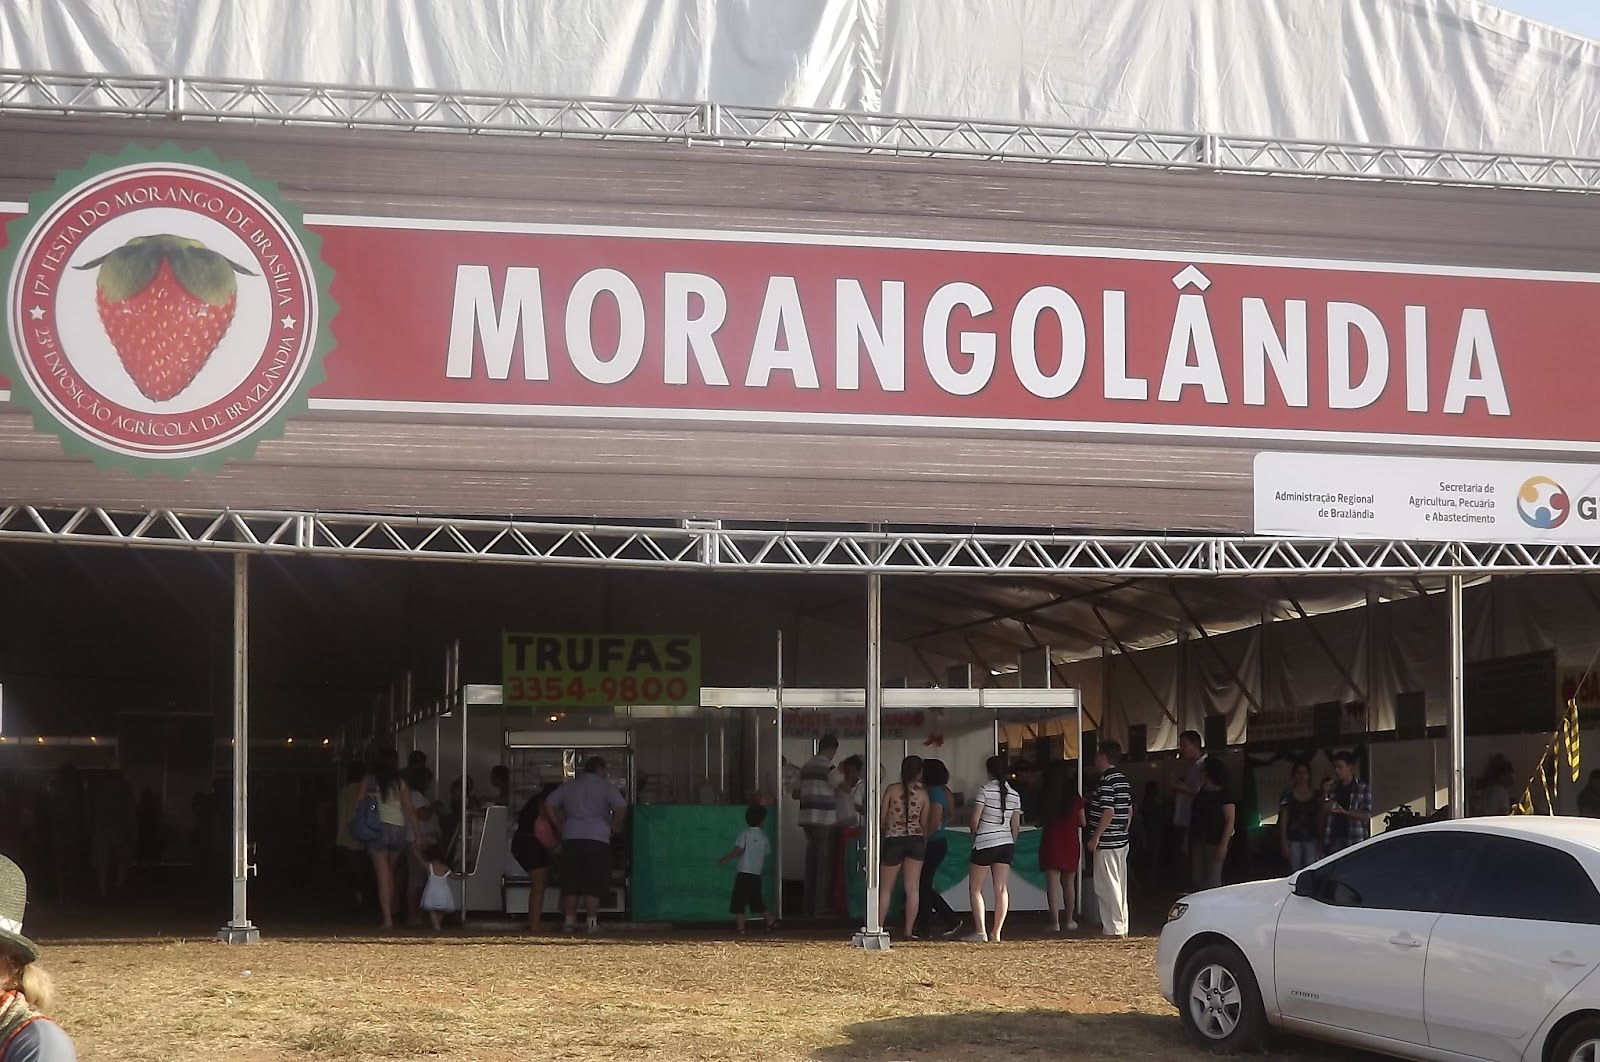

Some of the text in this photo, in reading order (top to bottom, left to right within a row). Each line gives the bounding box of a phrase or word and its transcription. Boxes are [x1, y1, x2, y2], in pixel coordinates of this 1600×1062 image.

[41, 225, 83, 272] FESTA
[78, 201, 111, 227] DO
[114, 186, 224, 213] MORANGO
[225, 206, 254, 233] DE
[249, 228, 293, 306] BRASÍLIA
[445, 264, 1511, 416] MORANGOLÂNDIA
[43, 350, 112, 421] EXPOSIÇÃO
[111, 415, 199, 437] AGRÍCOLA
[201, 411, 227, 431] DE
[225, 336, 295, 421] BRAZLÂNDIA
[1274, 490, 1374, 506] Administração Regional
[1439, 481, 1495, 493] Secretaria de
[1318, 507, 1375, 519] de Brazlândia
[1459, 497, 1495, 508] Pecuária
[1577, 496, 1600, 520] G
[1425, 511, 1496, 524] e Abastecimento
[507, 635, 692, 673] TRUFAS
[507, 676, 688, 702] 3354-9800
